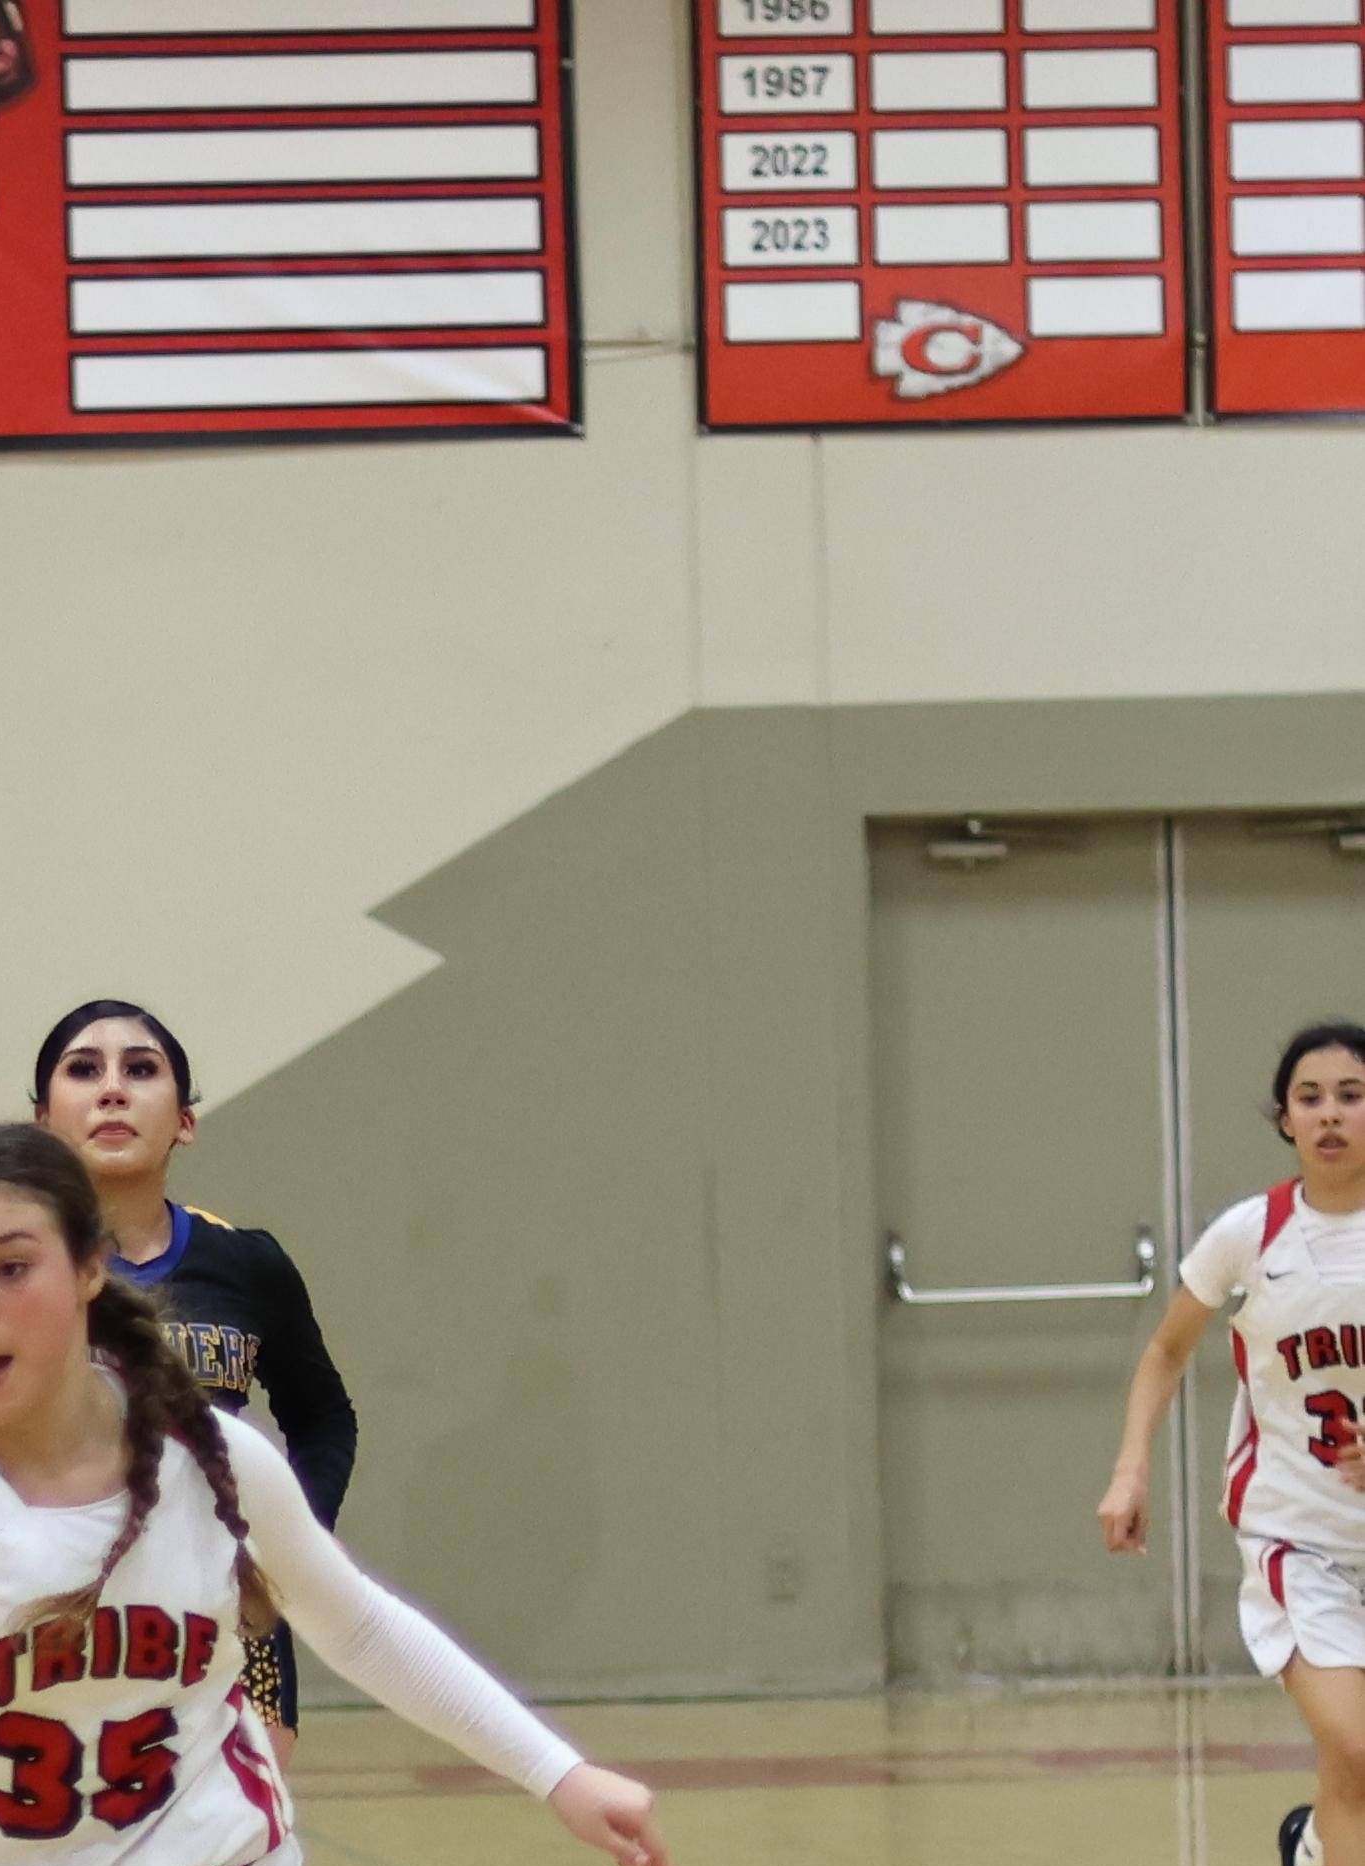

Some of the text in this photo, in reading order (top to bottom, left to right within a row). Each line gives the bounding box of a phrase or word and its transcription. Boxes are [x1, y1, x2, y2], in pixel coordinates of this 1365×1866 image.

[743, 65, 829, 98] 1987
[749, 144, 828, 177] 2022
[750, 218, 830, 252] 2023
[1276, 1323, 1365, 1382] TRI
